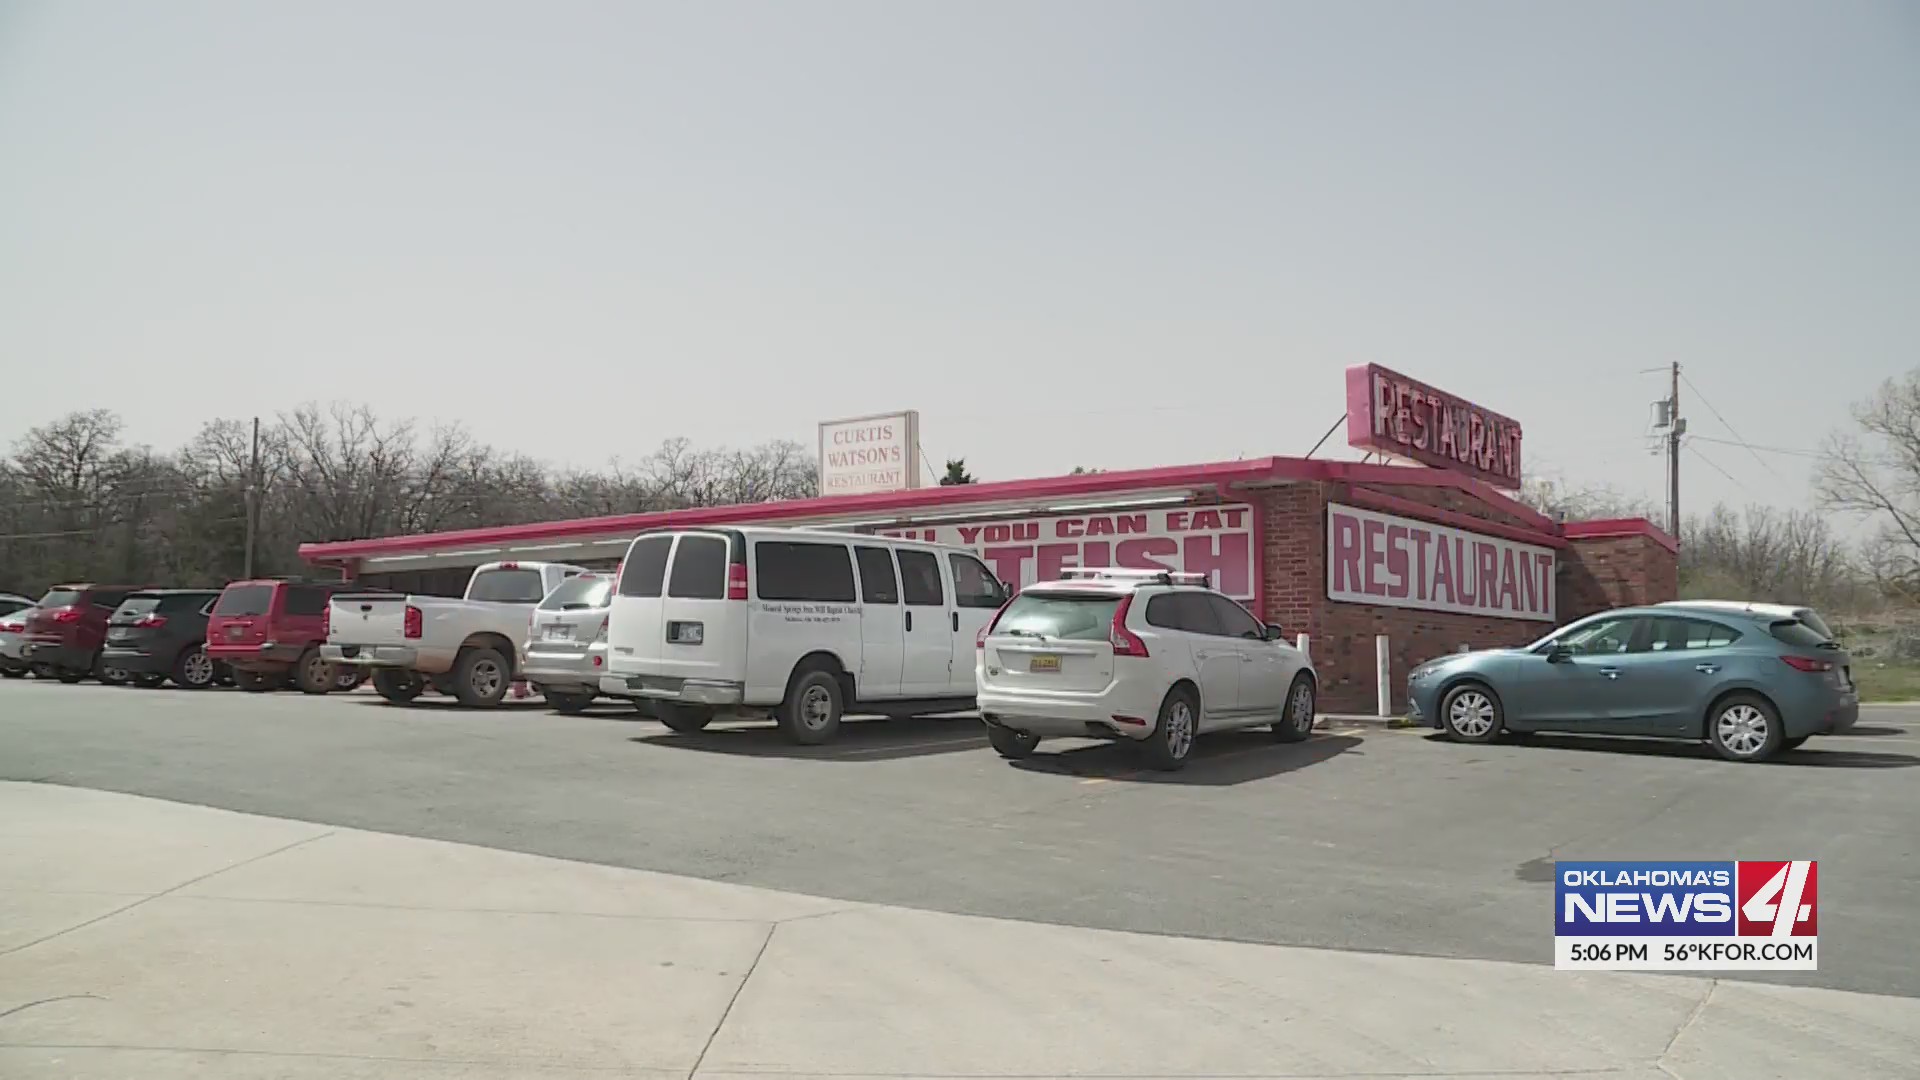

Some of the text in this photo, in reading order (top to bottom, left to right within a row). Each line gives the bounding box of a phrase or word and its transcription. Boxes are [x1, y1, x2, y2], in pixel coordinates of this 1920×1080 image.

[834, 425, 893, 445] CURTIS
[1374, 373, 1522, 479] RESTAURANT
[828, 445, 900, 468] WATSON'S
[828, 471, 900, 488] RESTAURANT
[958, 522, 1039, 544] YOU
[1056, 514, 1147, 537] CAN
[1166, 507, 1249, 531] EAT
[985, 532, 1250, 598] TFISH
[1333, 513, 1553, 614] RESTAURANT
